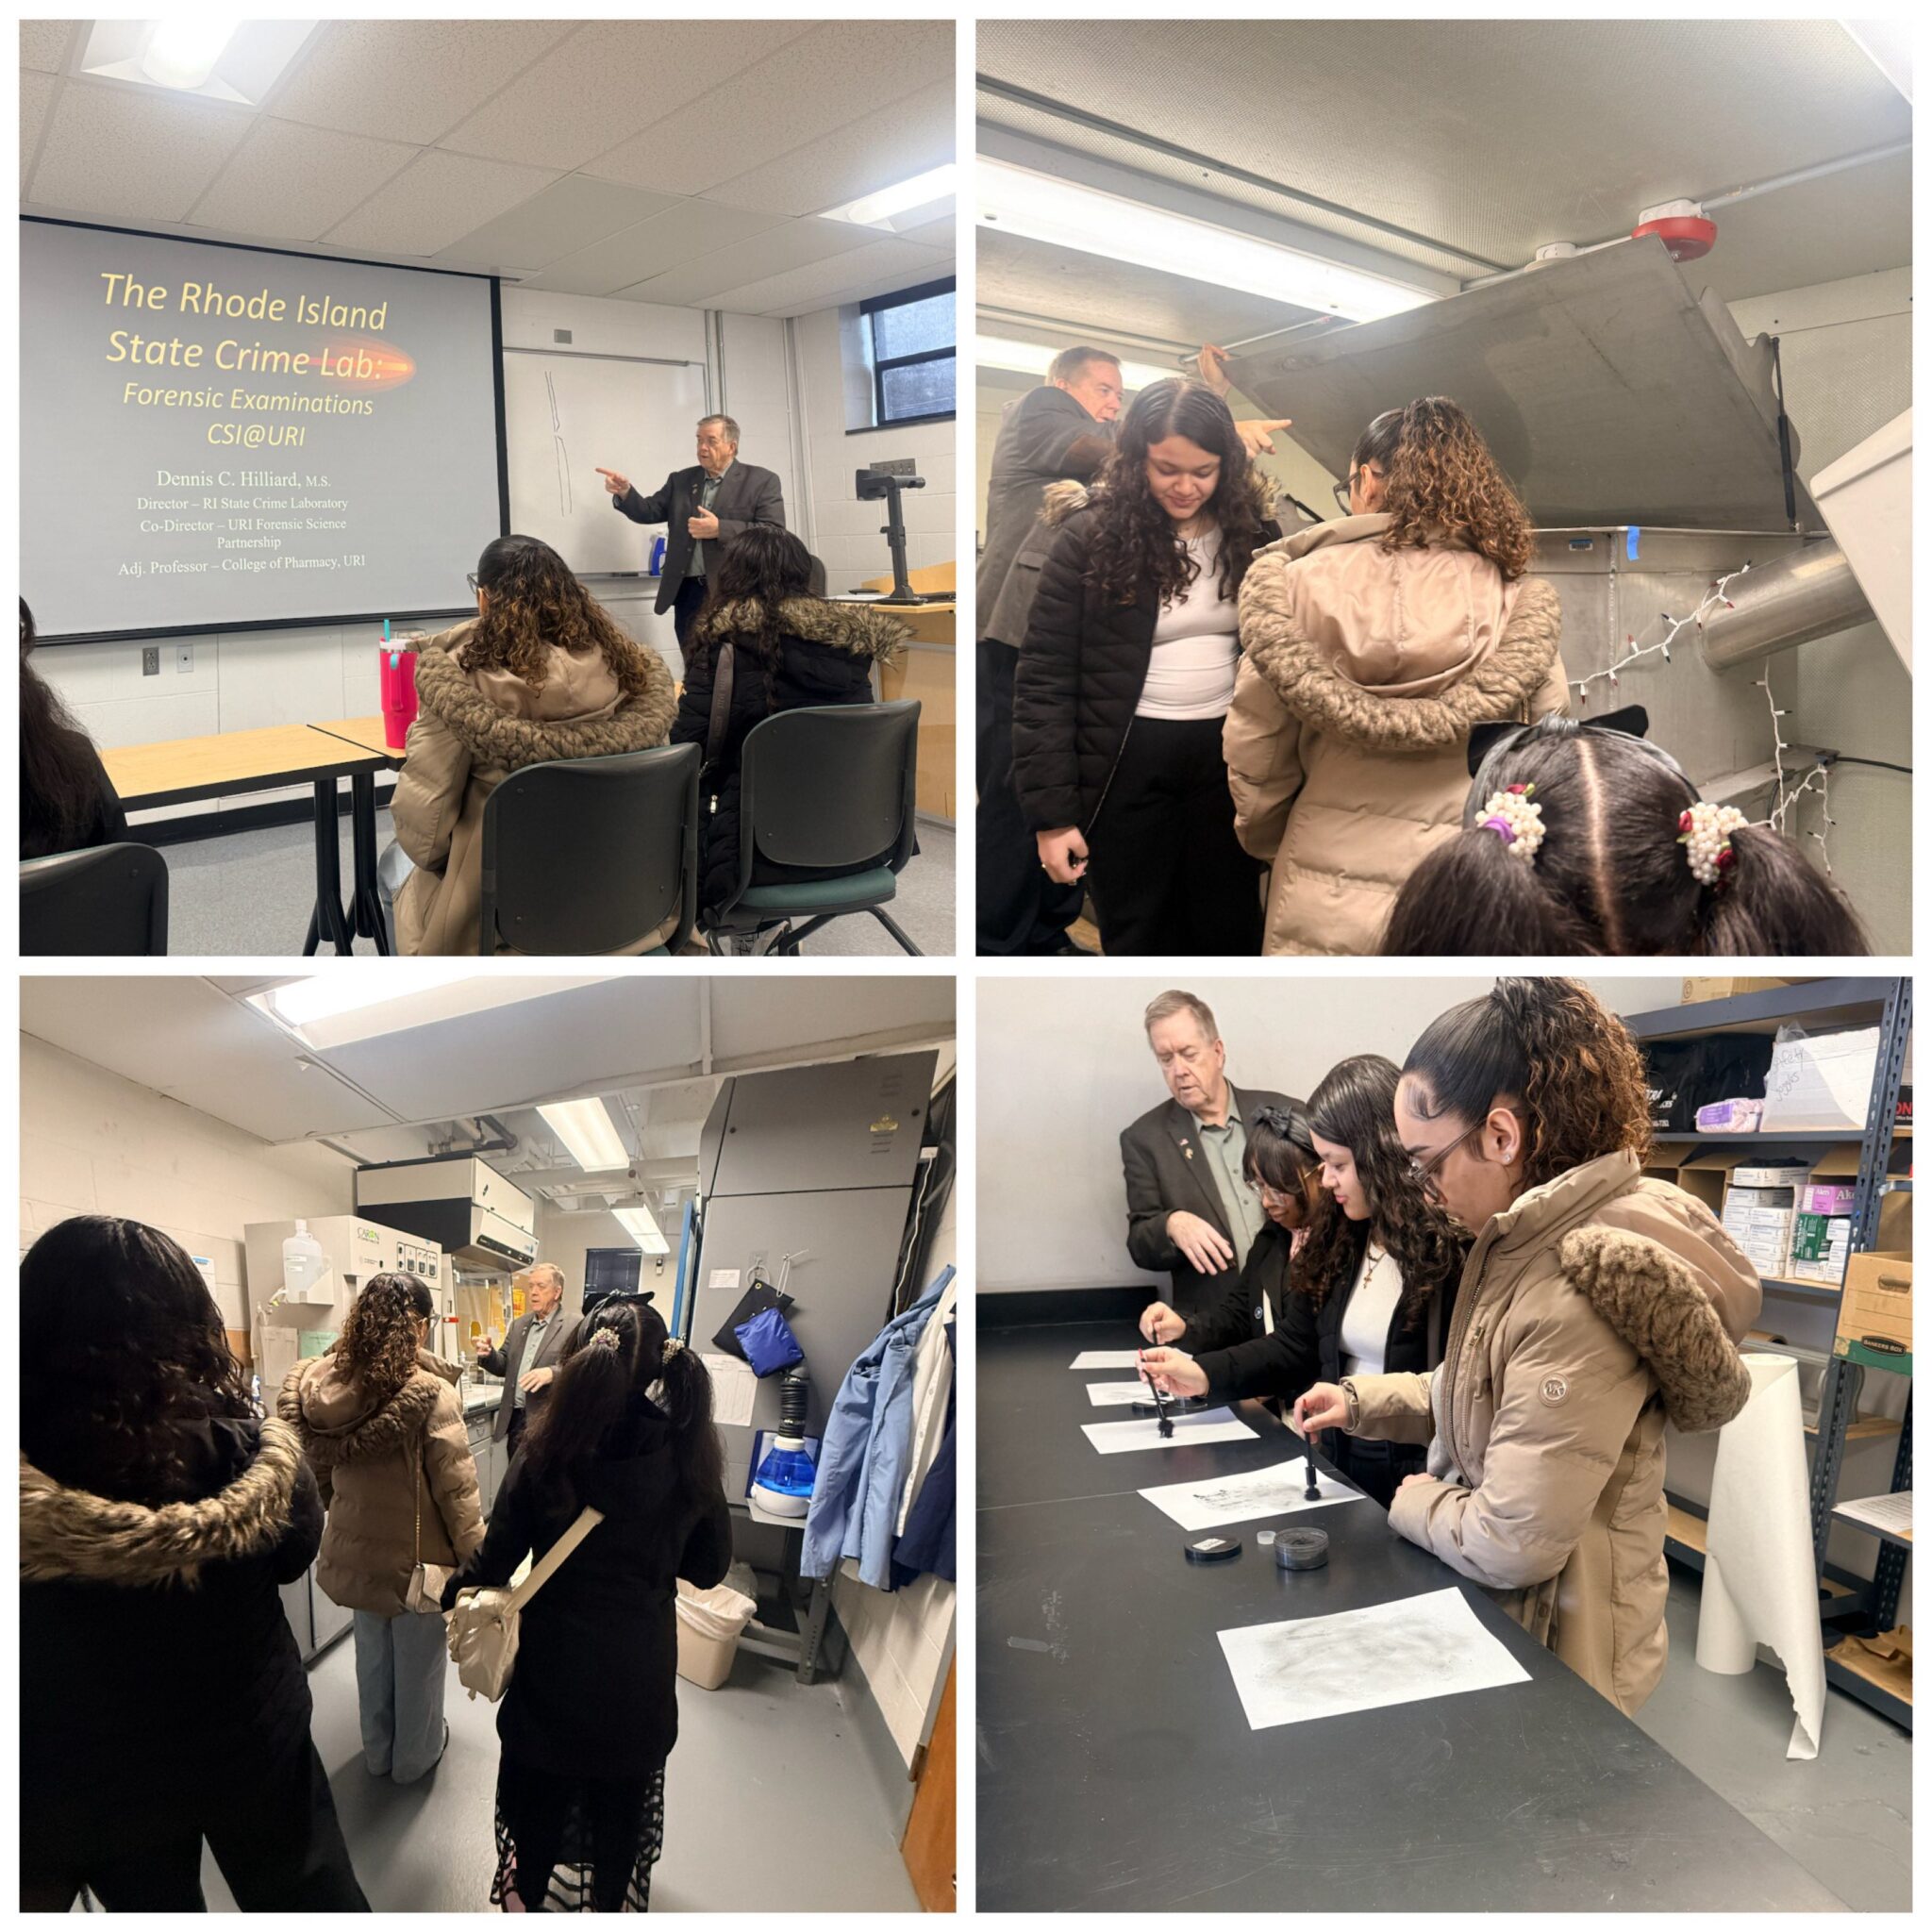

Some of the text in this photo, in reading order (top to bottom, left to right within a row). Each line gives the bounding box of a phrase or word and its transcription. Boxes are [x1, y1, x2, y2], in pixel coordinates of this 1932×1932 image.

[101, 273, 388, 330] The Rhode Island
[106, 330, 382, 379] State Crime Lab:
[123, 382, 374, 415] Forensic Examinations
[208, 424, 306, 448] CSI@URI
[157, 470, 331, 490] Dennis C. Hilliard, M.S.
[137, 497, 189, 509] Director
[203, 497, 217, 509] RI
[221, 497, 250, 508] State
[253, 497, 288, 509] Crime
[291, 497, 348, 511] Laboratory
[140, 519, 214, 532] Co-Director
[228, 519, 253, 530] URI
[256, 518, 303, 530] Forensic
[306, 517, 347, 529] Science
[217, 535, 282, 550] Partnership
[118, 562, 146, 577] Adj.
[150, 559, 208, 574] Professor
[222, 558, 267, 573] College
[269, 557, 283, 569] of
[285, 556, 341, 570] Pharmacy,
[343, 555, 365, 566] URI
